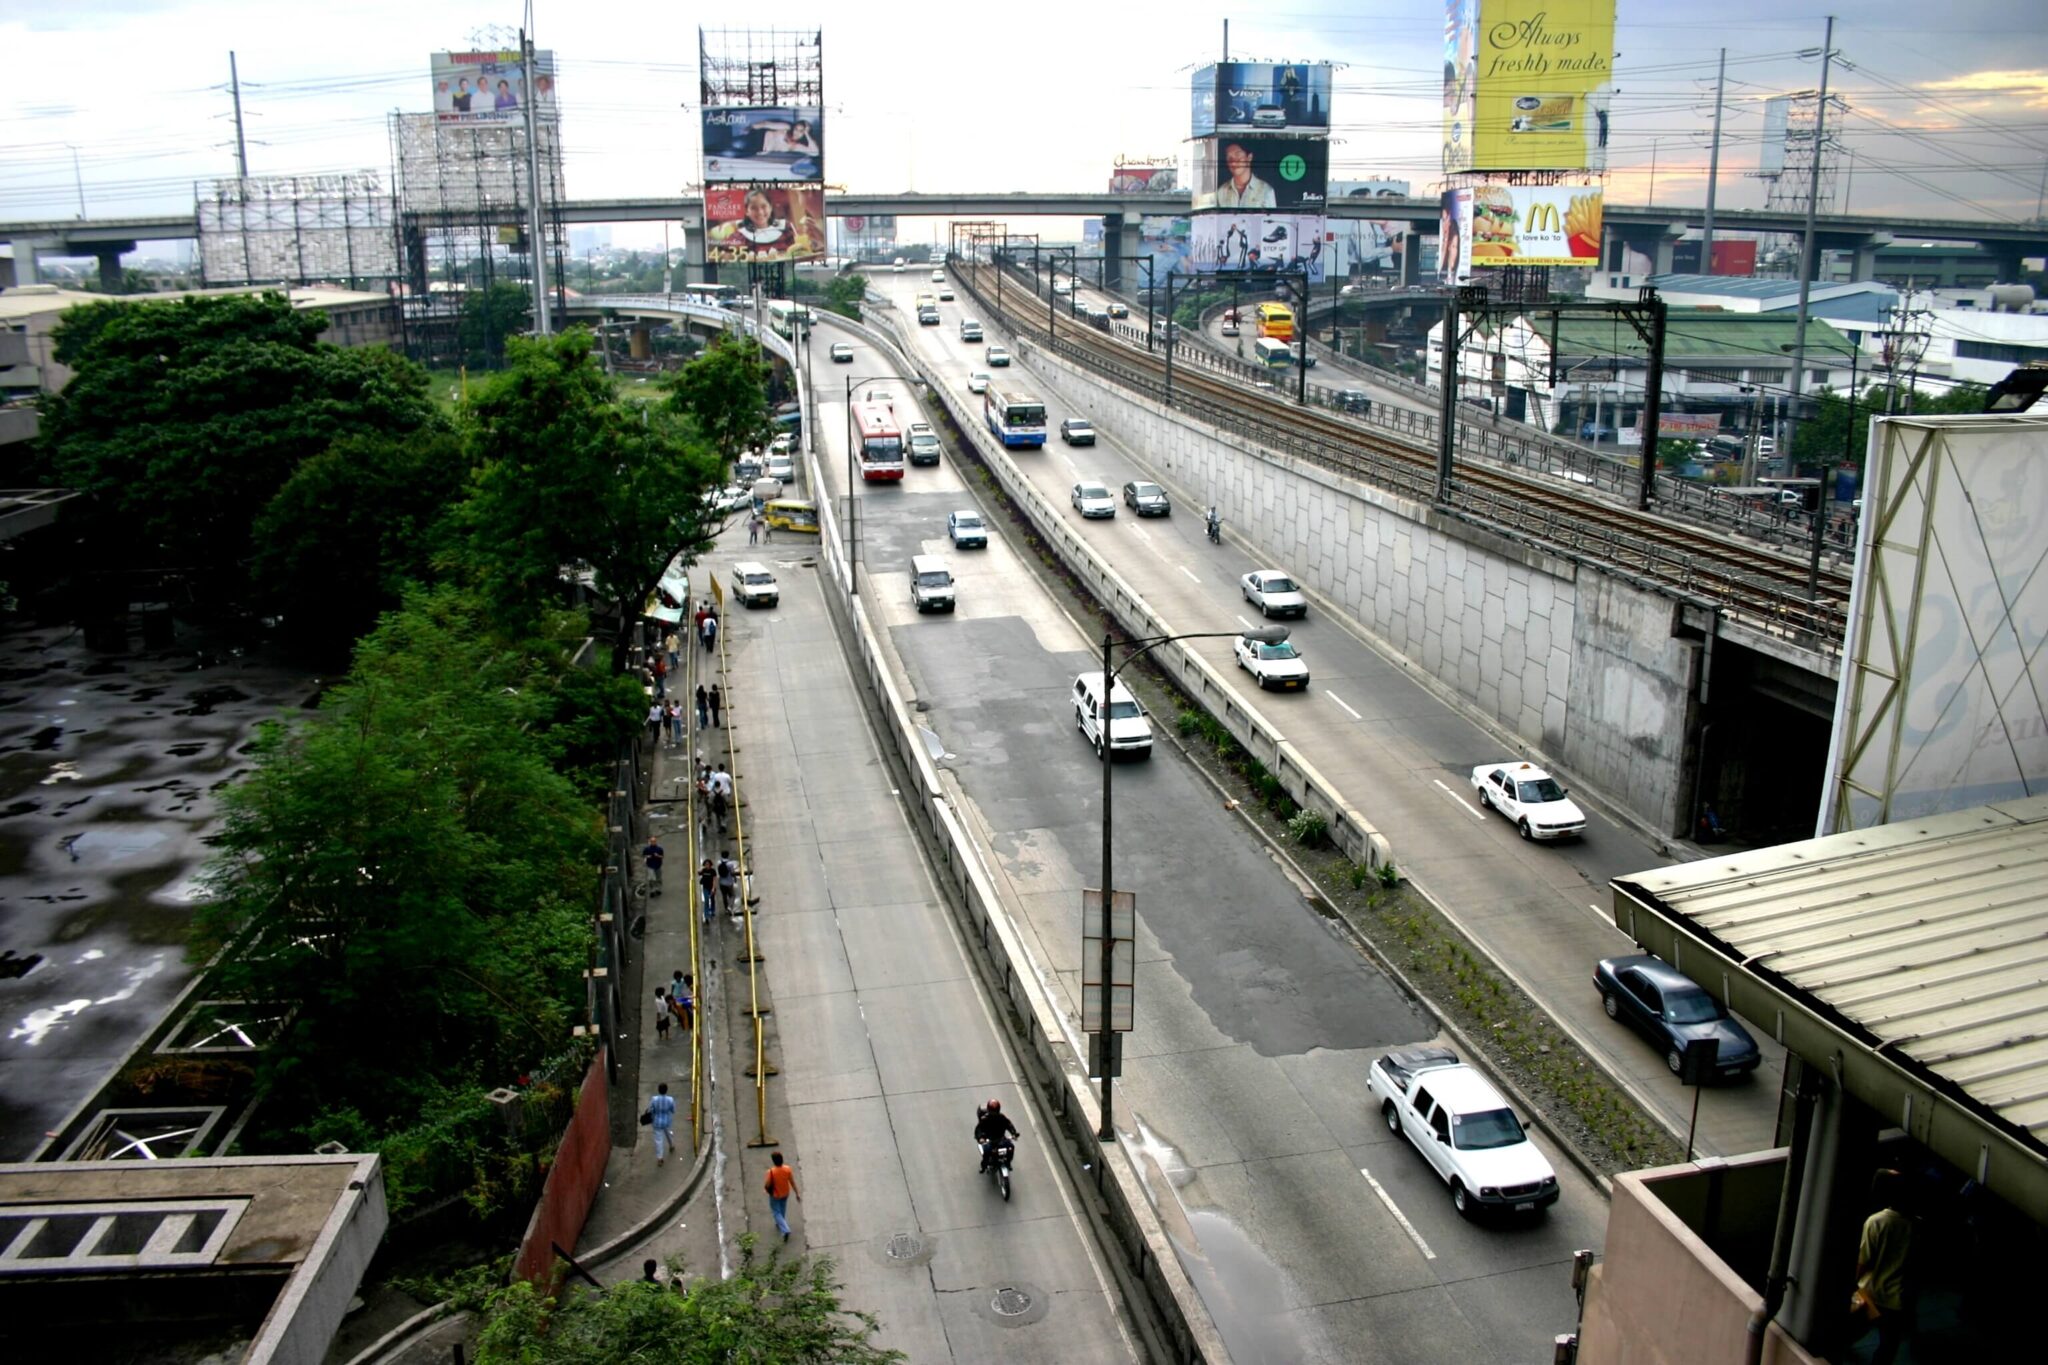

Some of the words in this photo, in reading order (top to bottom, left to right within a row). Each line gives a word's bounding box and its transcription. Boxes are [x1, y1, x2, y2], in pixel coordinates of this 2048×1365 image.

[1489, 12, 1582, 49] Always
[1488, 53, 1550, 77] freshly
[1556, 52, 1607, 70] made.
